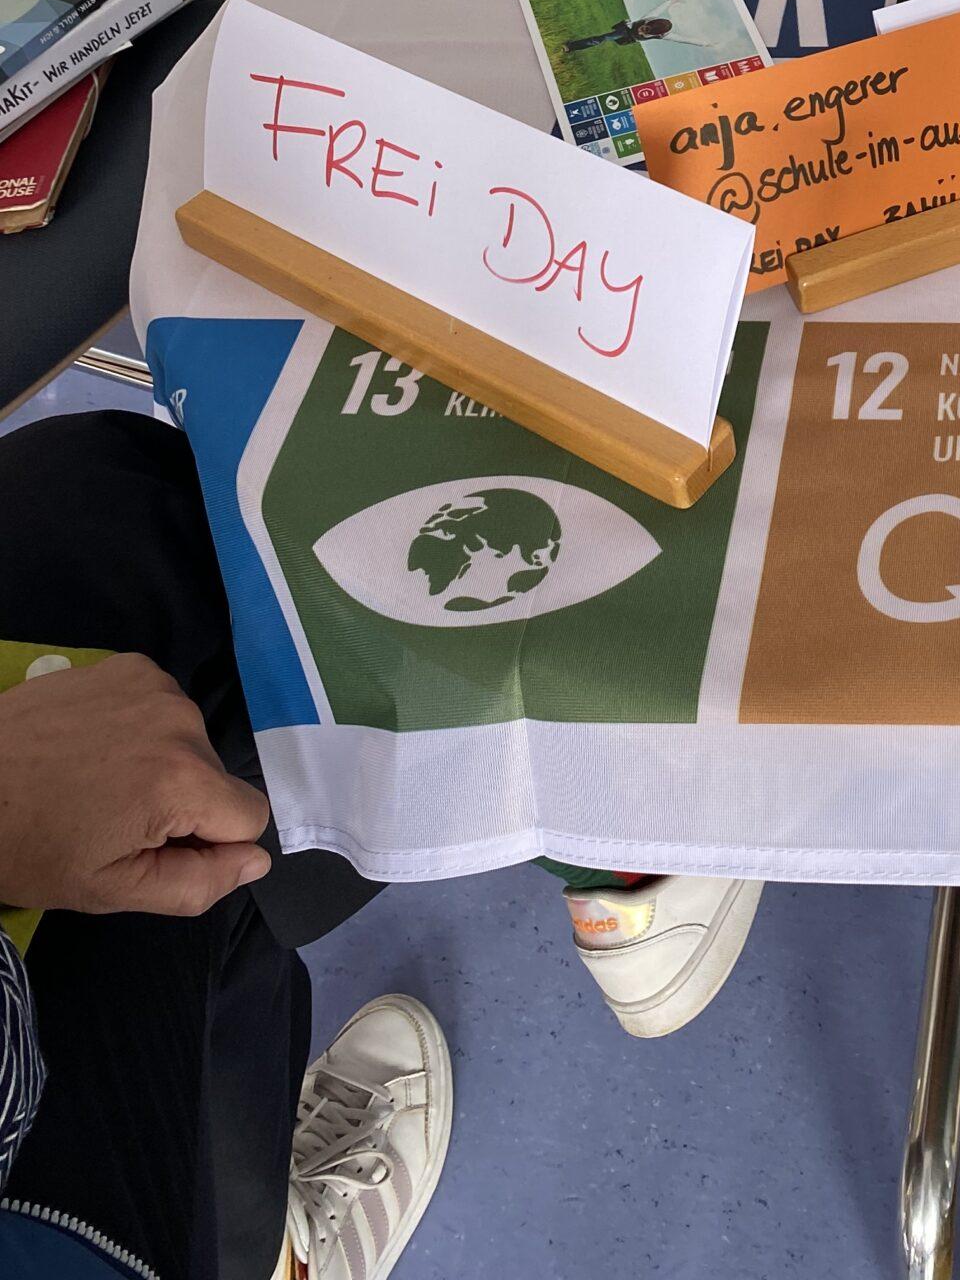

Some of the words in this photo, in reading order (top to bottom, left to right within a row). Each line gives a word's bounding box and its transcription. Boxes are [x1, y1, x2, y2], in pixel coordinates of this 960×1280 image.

[42, 61, 69, 83] WIR
[70, 22, 121, 65] HANDELN
[124, 1, 153, 32] JETZT
[0, 176, 37, 189] ONAL
[340, 351, 424, 417] 13
[826, 351, 910, 421] 12
